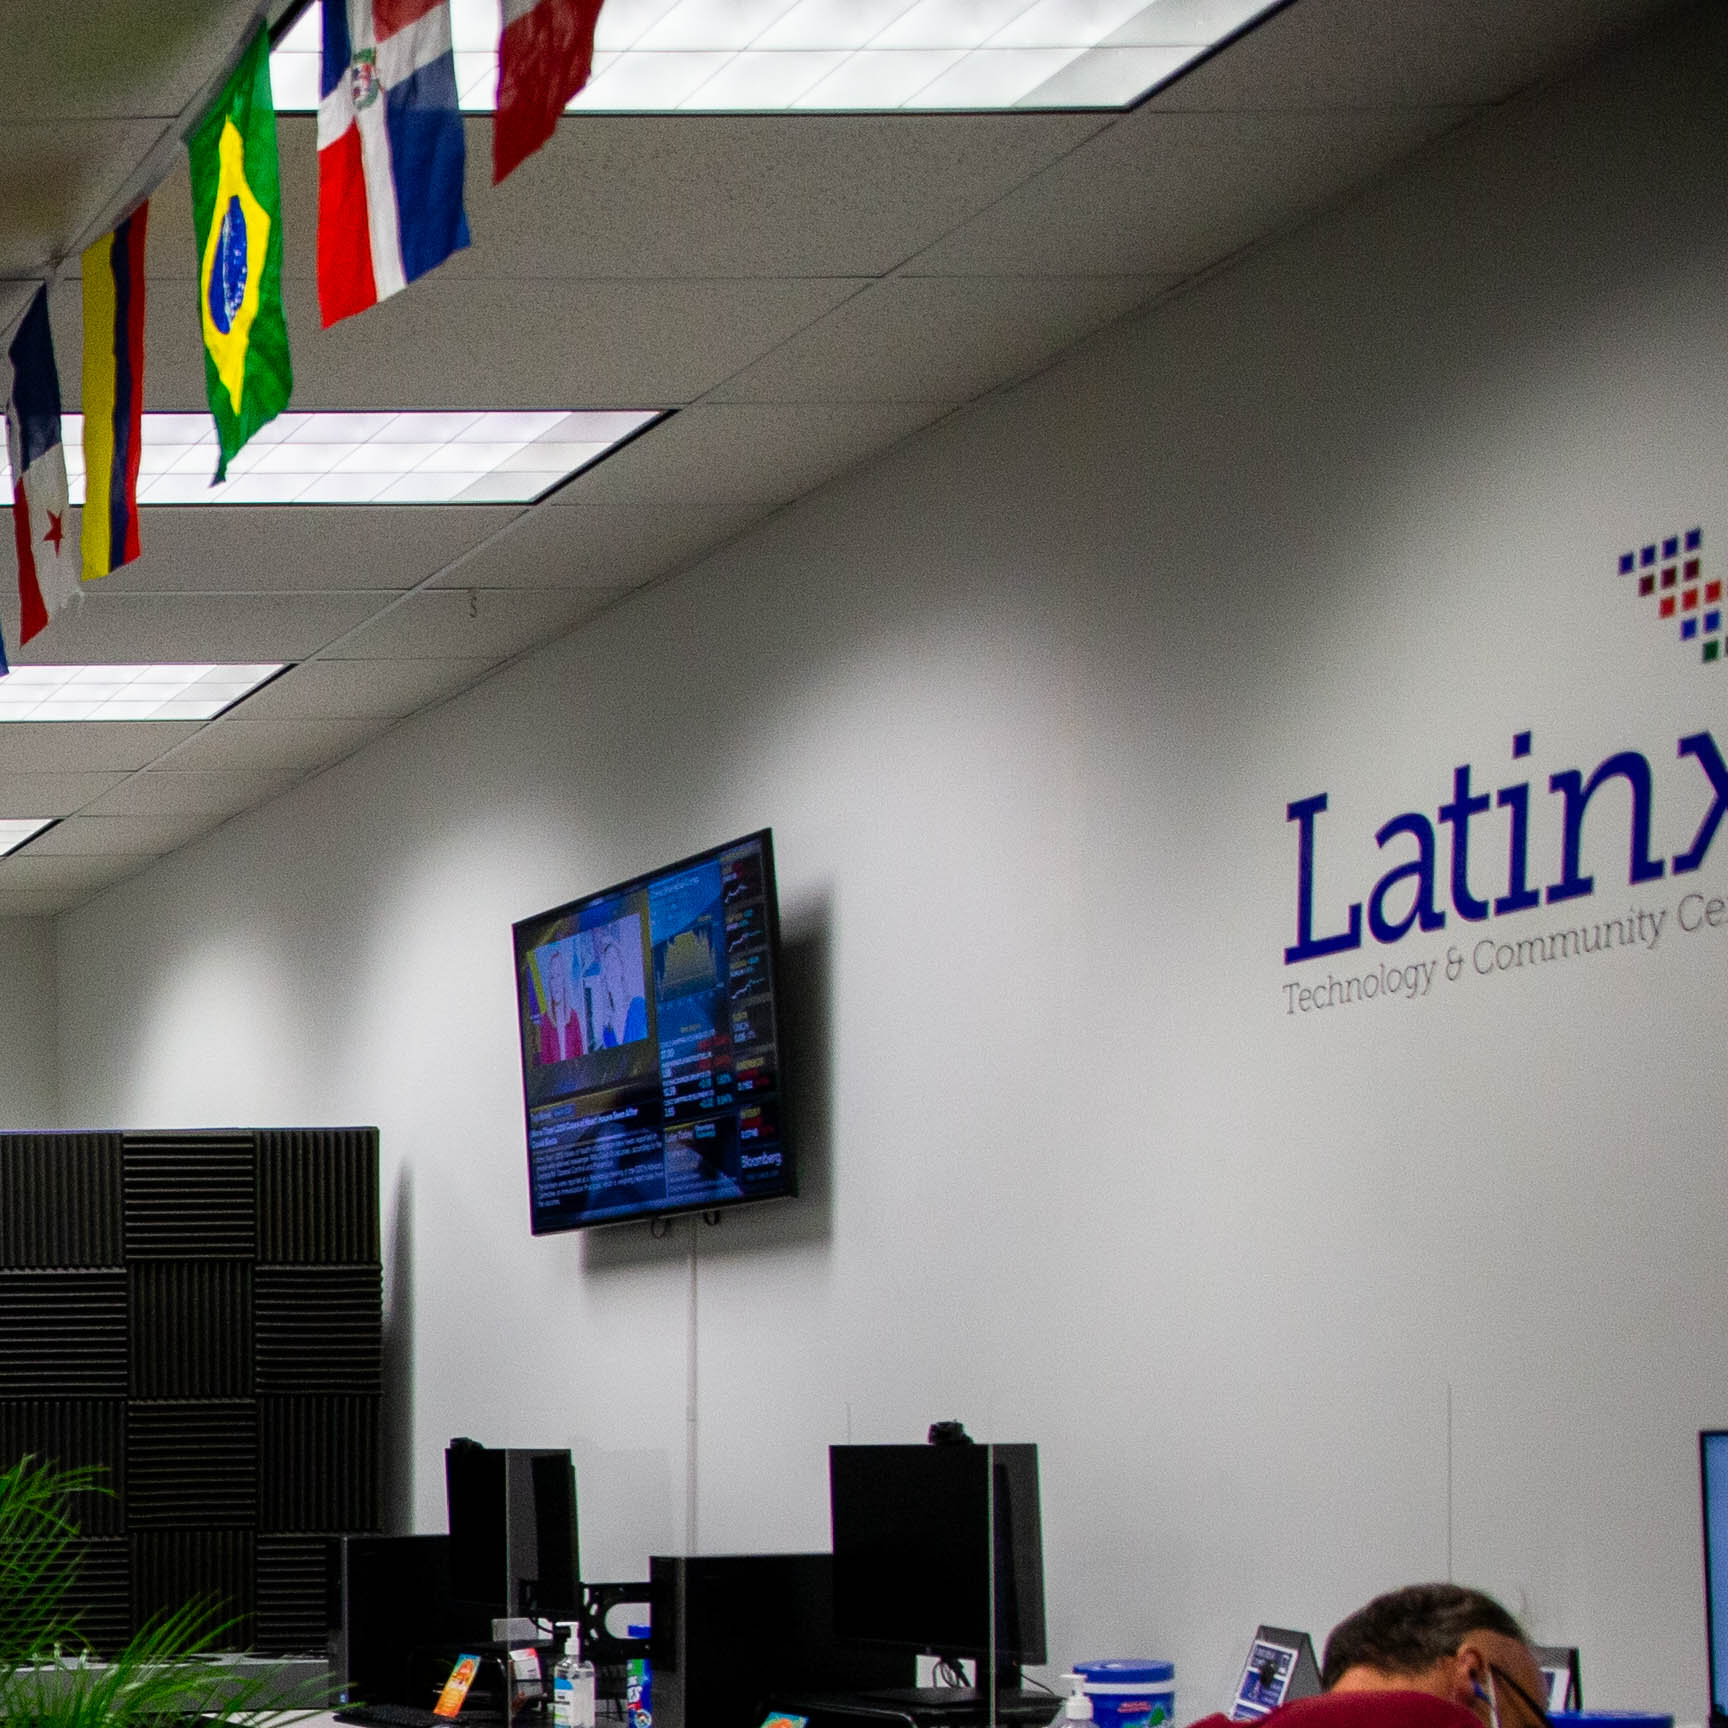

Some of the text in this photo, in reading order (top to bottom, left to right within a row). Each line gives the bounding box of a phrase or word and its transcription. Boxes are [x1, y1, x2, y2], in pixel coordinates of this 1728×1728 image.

[1282, 893, 1728, 1016] Technology & Community Ce
